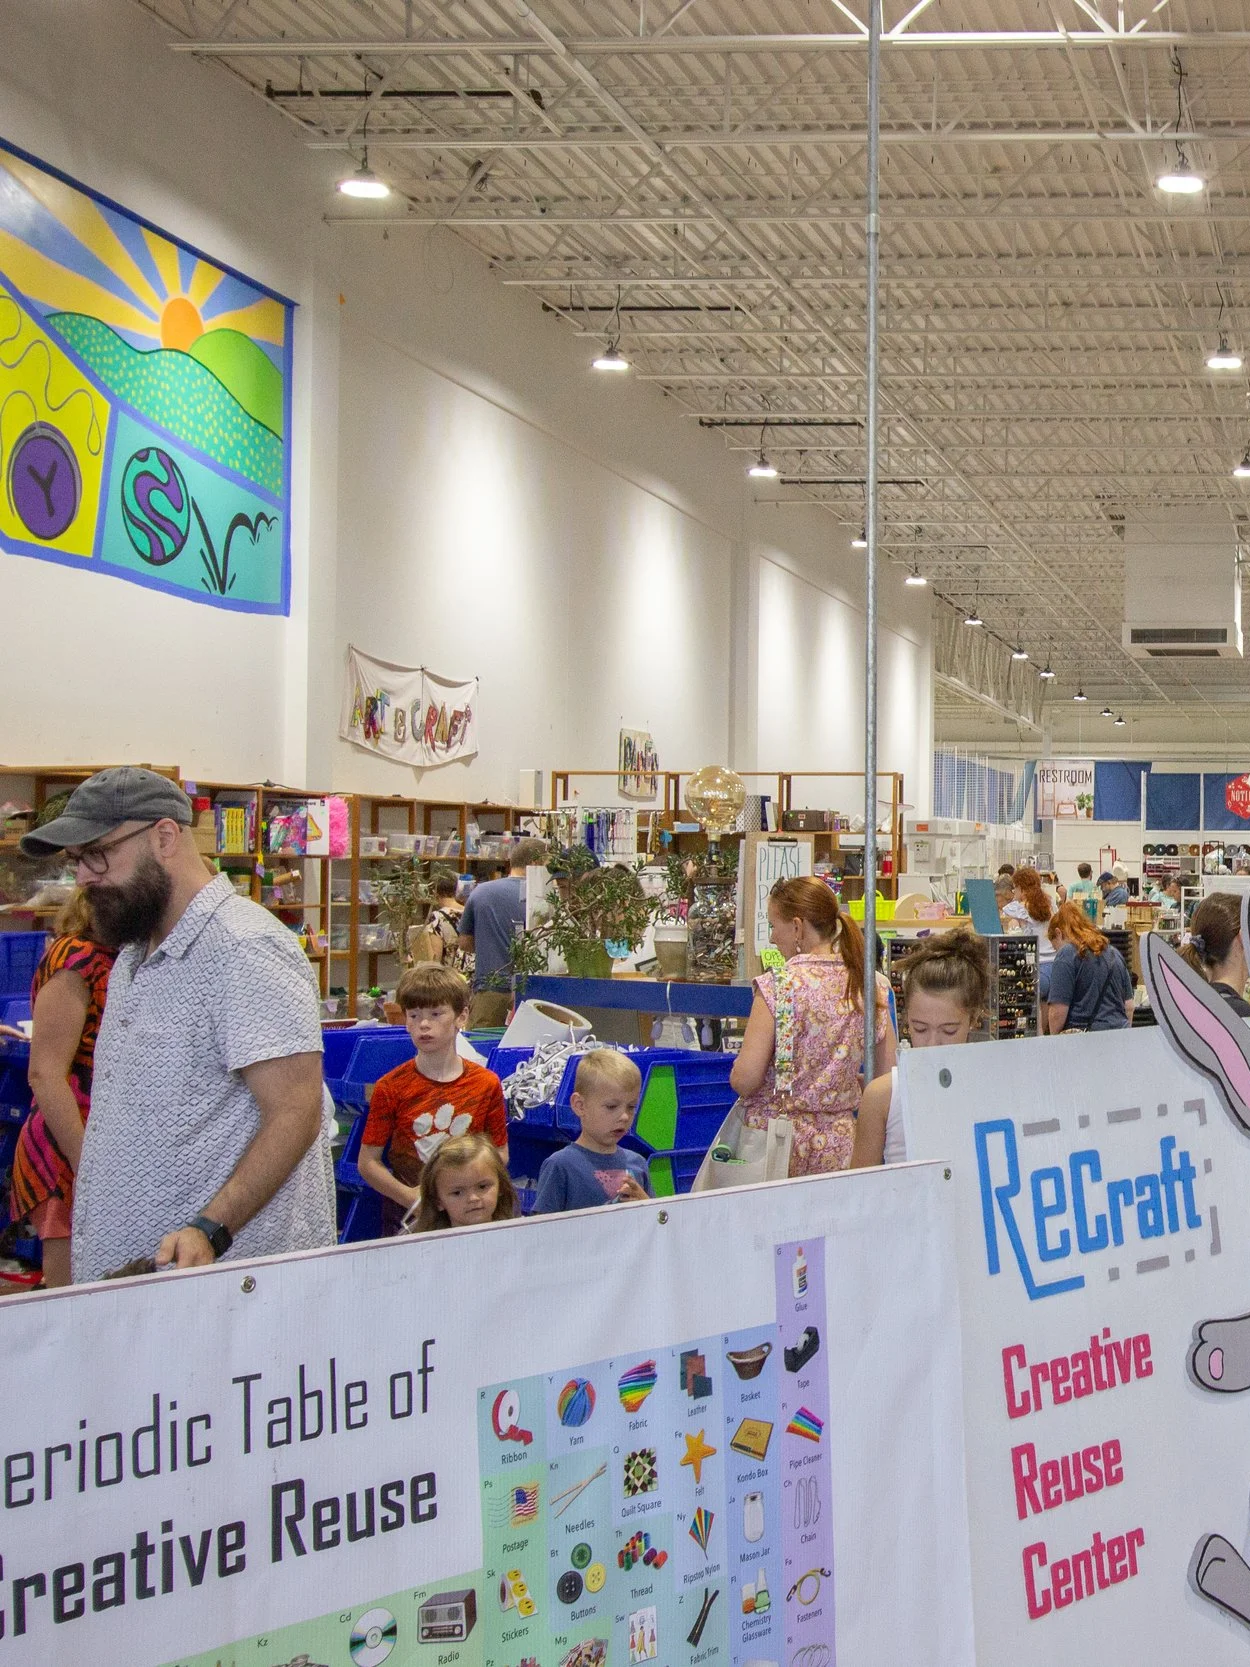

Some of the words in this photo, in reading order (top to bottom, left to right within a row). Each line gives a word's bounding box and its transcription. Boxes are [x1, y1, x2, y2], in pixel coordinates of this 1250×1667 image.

[351, 686, 391, 743] ART
[411, 699, 472, 752] CRAFT
[1039, 769, 1092, 784] RESTROOM
[975, 1119, 1202, 1300] ReCraft
[795, 1303, 808, 1312] Glue
[609, 1362, 614, 1370] F
[548, 1377, 554, 1385] Y
[1001, 1328, 1153, 1420] Creative
[797, 1379, 810, 1389] Tape
[480, 1391, 486, 1400] R
[741, 1391, 761, 1403] Basket
[688, 1405, 707, 1417] Leather
[4, 1393, 212, 1509] eriodic
[232, 1358, 368, 1454] Table
[390, 1339, 436, 1420] of
[629, 1419, 648, 1431] Fabric
[569, 1436, 584, 1447] Yarn
[501, 1452, 528, 1464] Ribbon
[789, 1459, 802, 1470] Pipe
[803, 1453, 822, 1466] Cleaner
[550, 1463, 559, 1471] Kn
[737, 1470, 757, 1484] Kondo
[757, 1468, 768, 1478] Box
[1011, 1439, 1124, 1520] Reuse
[695, 1486, 705, 1496] Felt
[784, 1480, 792, 1488] Ch
[621, 1506, 636, 1518] Quilt
[637, 1500, 662, 1514] Square
[677, 1514, 686, 1522] Ny
[565, 1519, 595, 1534] Needles
[616, 1530, 623, 1538] Th
[800, 1533, 817, 1544] Chain
[502, 1538, 529, 1553] Postage
[0, 1519, 247, 1640] reative
[271, 1472, 438, 1564] Reuse
[551, 1550, 559, 1558] Bt
[740, 1551, 760, 1563] Mason
[761, 1547, 770, 1556] Jar
[487, 1570, 496, 1578] Sk
[683, 1569, 704, 1585] Ripstop
[704, 1563, 721, 1579] Nylon
[1022, 1527, 1145, 1620] Center
[413, 1590, 427, 1600] Fm
[630, 1584, 653, 1599] Thread
[339, 1612, 351, 1623] Cd
[570, 1605, 597, 1621] Buttons
[797, 1608, 823, 1623] Fasteners
[741, 1614, 772, 1632] Chemistry
[502, 1627, 529, 1642] Stickers
[555, 1636, 567, 1646] Mg
[742, 1627, 772, 1643] Glassware
[257, 1638, 268, 1648] Kz
[438, 1651, 460, 1665] Radio
[690, 1652, 706, 1665] Fabric
[706, 1646, 719, 1658] Trim
